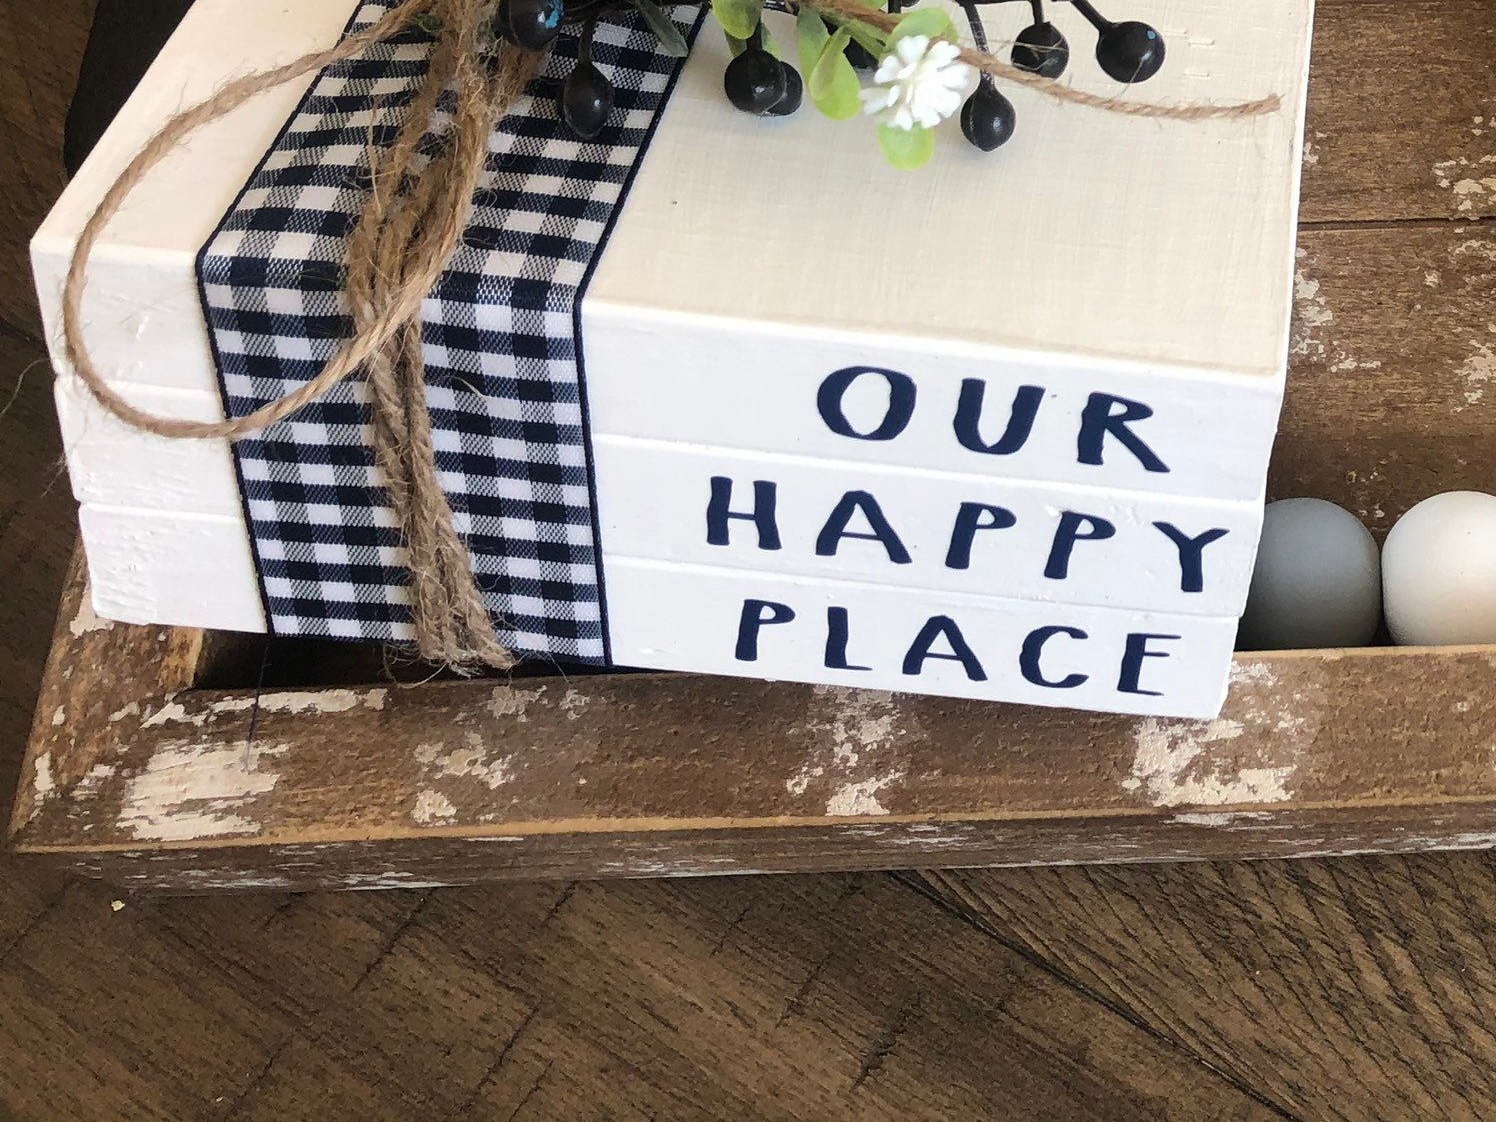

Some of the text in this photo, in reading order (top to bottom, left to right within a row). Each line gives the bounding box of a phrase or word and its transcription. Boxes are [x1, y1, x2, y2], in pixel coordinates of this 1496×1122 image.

[816, 365, 1171, 473] OUR
[706, 476, 1230, 593] HAPPY
[735, 599, 1182, 697] PLACE
